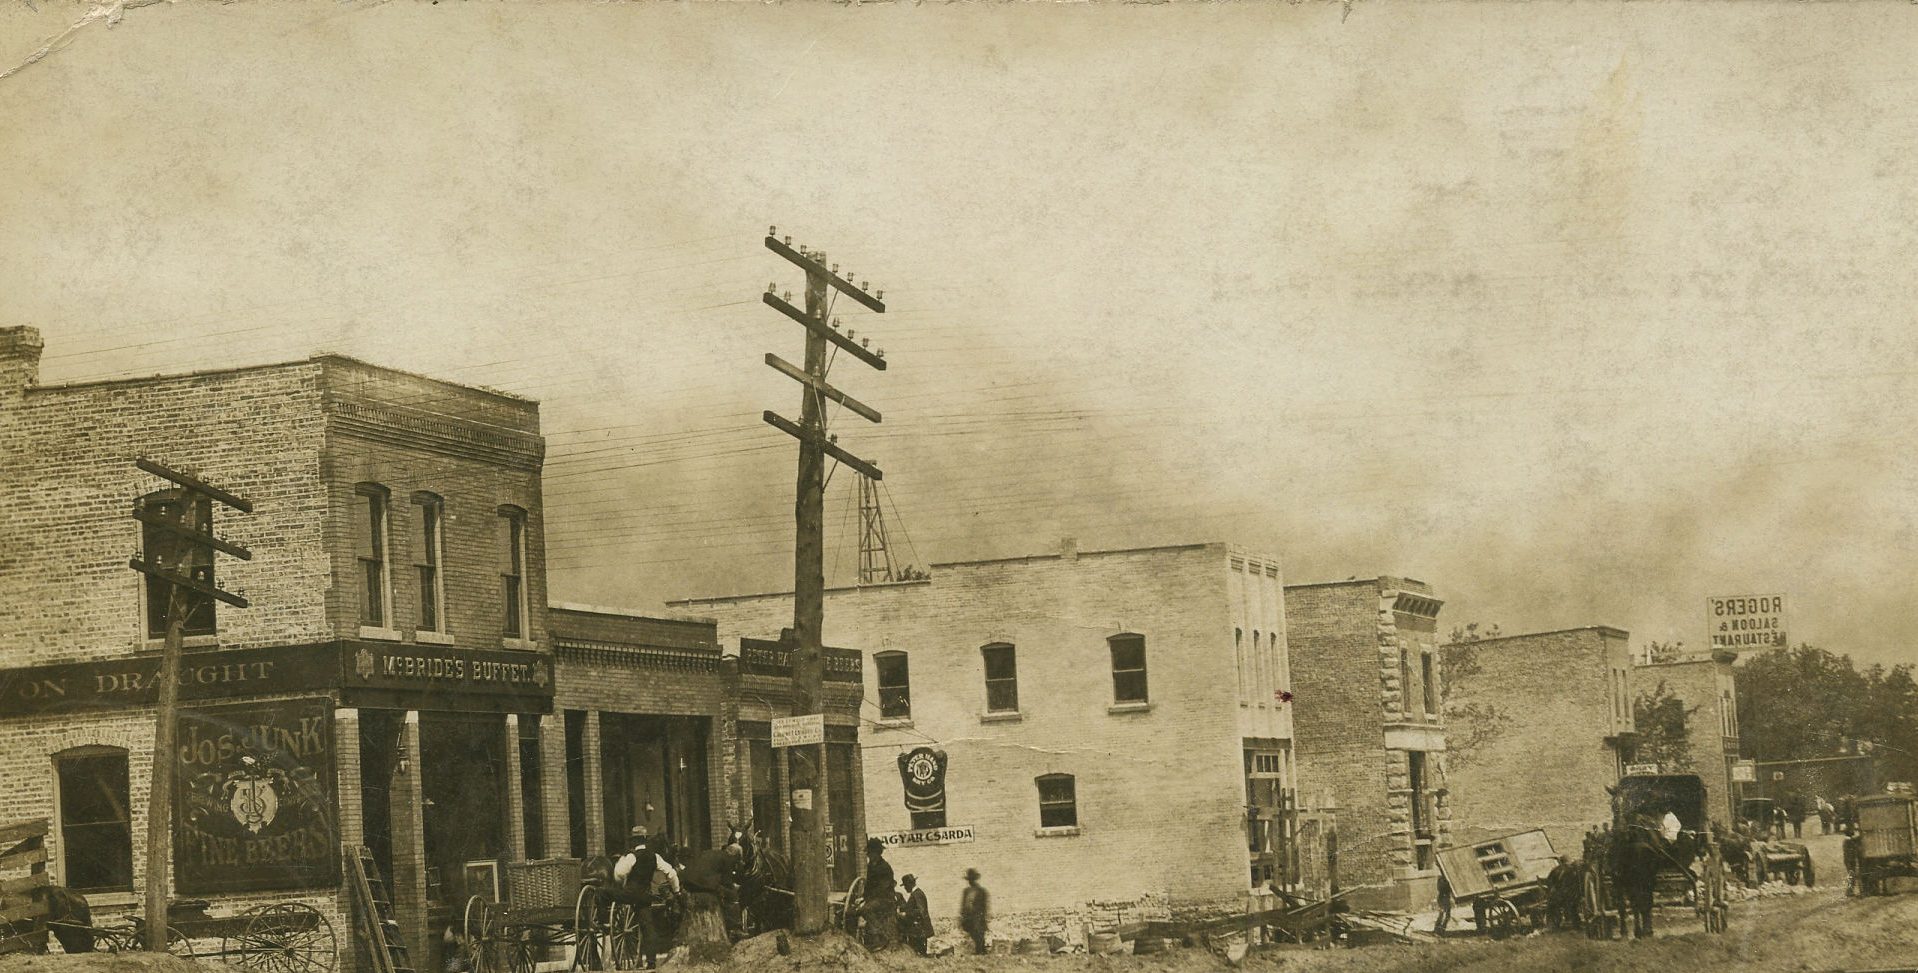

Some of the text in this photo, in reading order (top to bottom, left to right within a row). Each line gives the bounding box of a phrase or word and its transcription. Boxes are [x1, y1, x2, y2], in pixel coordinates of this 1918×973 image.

[20, 678, 66, 698] ON
[242, 716, 324, 758] JUNK
[907, 753, 924, 773] PETER
[880, 829, 972, 845] AGYAR CSARDA
